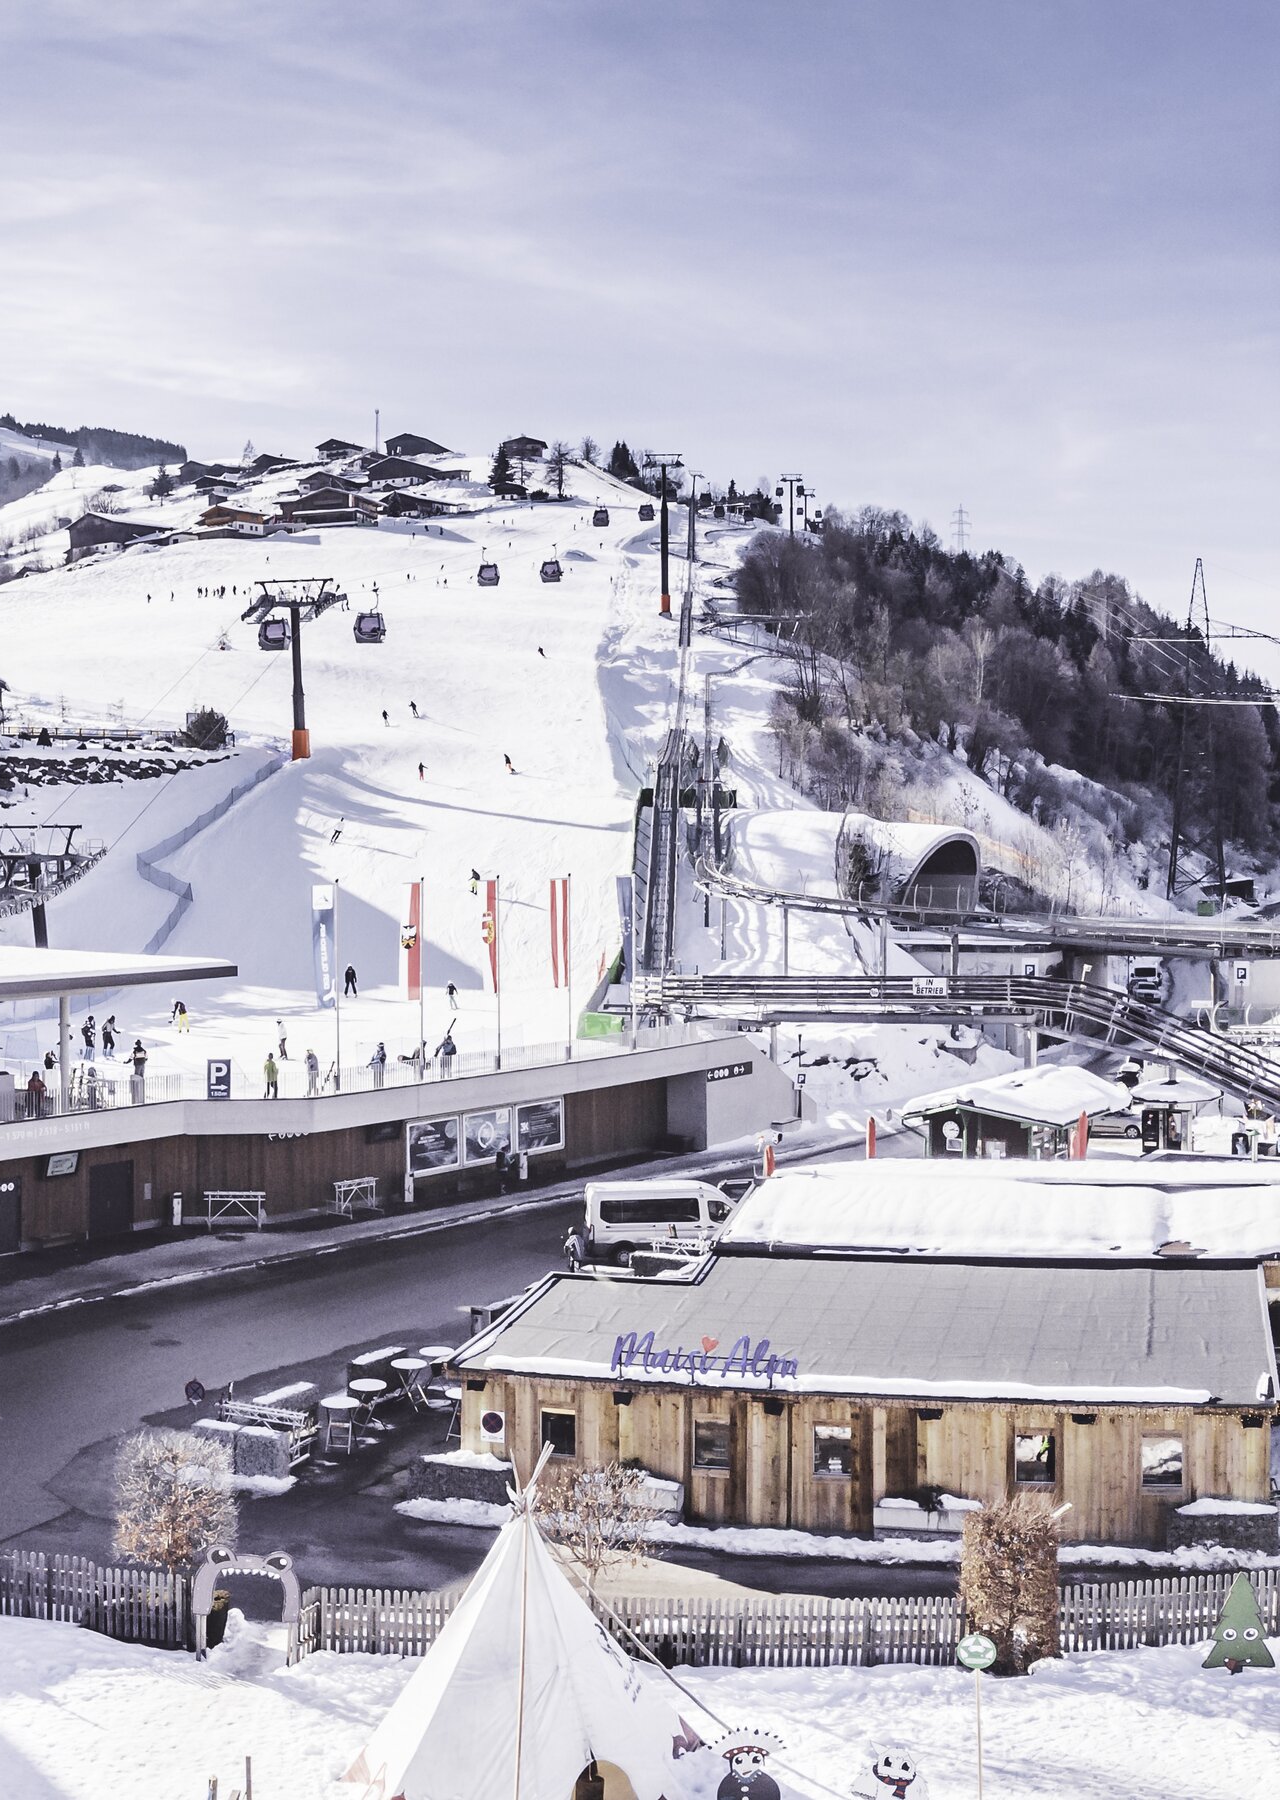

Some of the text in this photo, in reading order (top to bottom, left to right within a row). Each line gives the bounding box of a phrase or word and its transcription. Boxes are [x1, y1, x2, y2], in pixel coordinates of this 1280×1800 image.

[1026, 965, 1034, 975] P
[1238, 969, 1245, 978] P
[925, 978, 934, 986] IN
[915, 986, 944, 995] BETRIEB
[210, 1062, 228, 1084] P
[798, 1074, 804, 1083] P
[611, 1331, 799, 1380] Maisi Alm
